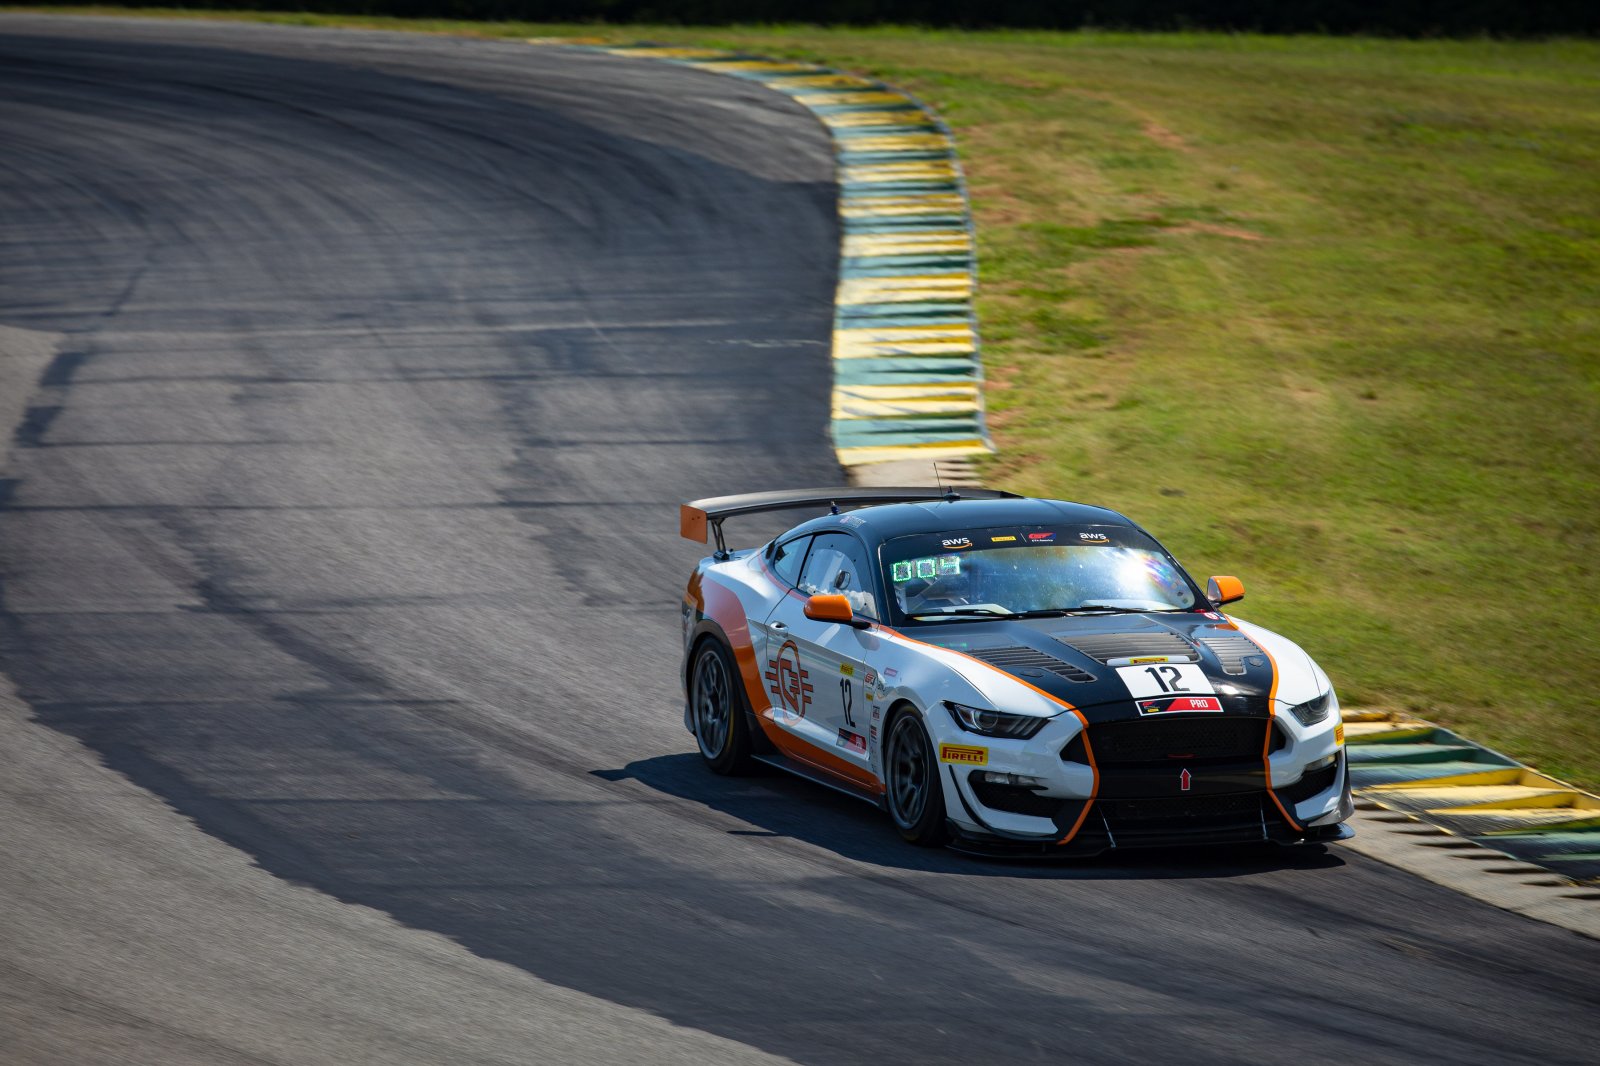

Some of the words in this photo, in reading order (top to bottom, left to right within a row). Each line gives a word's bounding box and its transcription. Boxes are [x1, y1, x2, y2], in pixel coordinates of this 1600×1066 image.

[942, 537, 970, 546] aws
[1079, 532, 1107, 540] aws
[1145, 666, 1190, 692] 12
[840, 677, 856, 728] 12
[1189, 699, 1209, 708] PRO
[942, 746, 984, 762] PIRELLI
